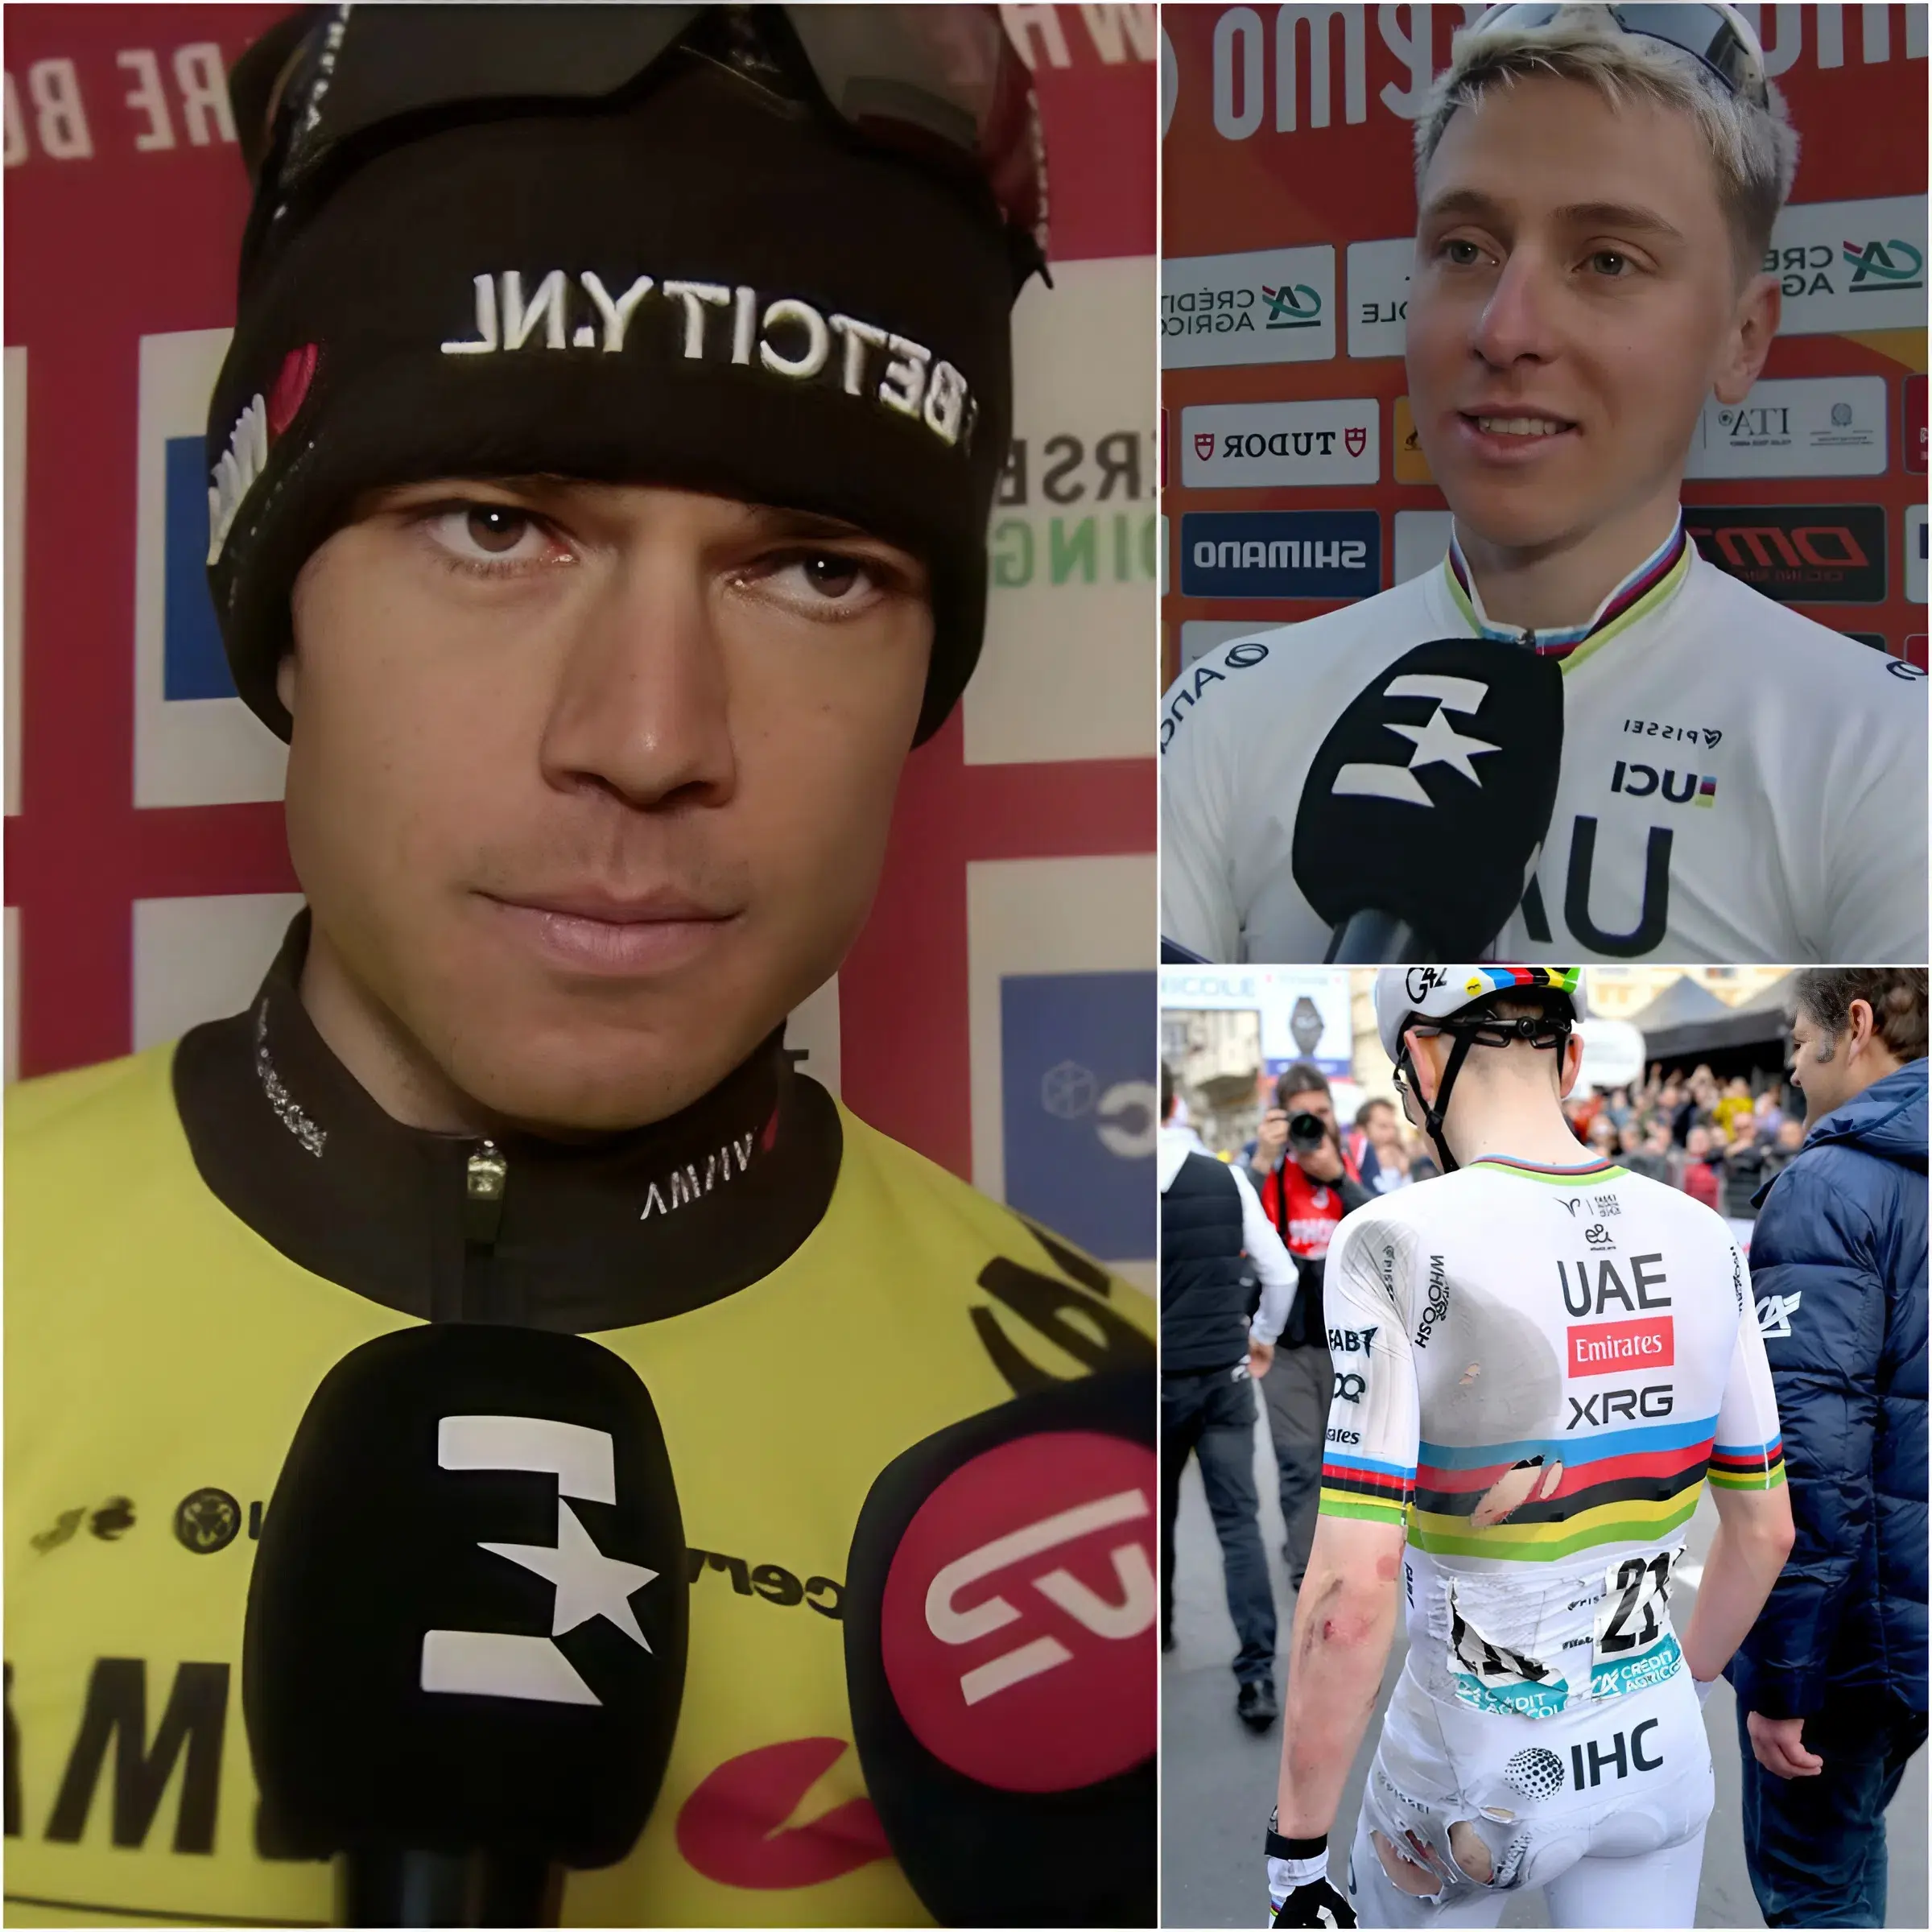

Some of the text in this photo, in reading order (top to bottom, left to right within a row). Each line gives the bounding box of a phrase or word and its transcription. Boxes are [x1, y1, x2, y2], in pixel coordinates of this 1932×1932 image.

[1557, 1253, 1672, 1318] UAE
[1575, 1333, 1663, 1363] Emirates
[1566, 1384, 1674, 1430] XRG
[1571, 1717, 1665, 1792] IHC
